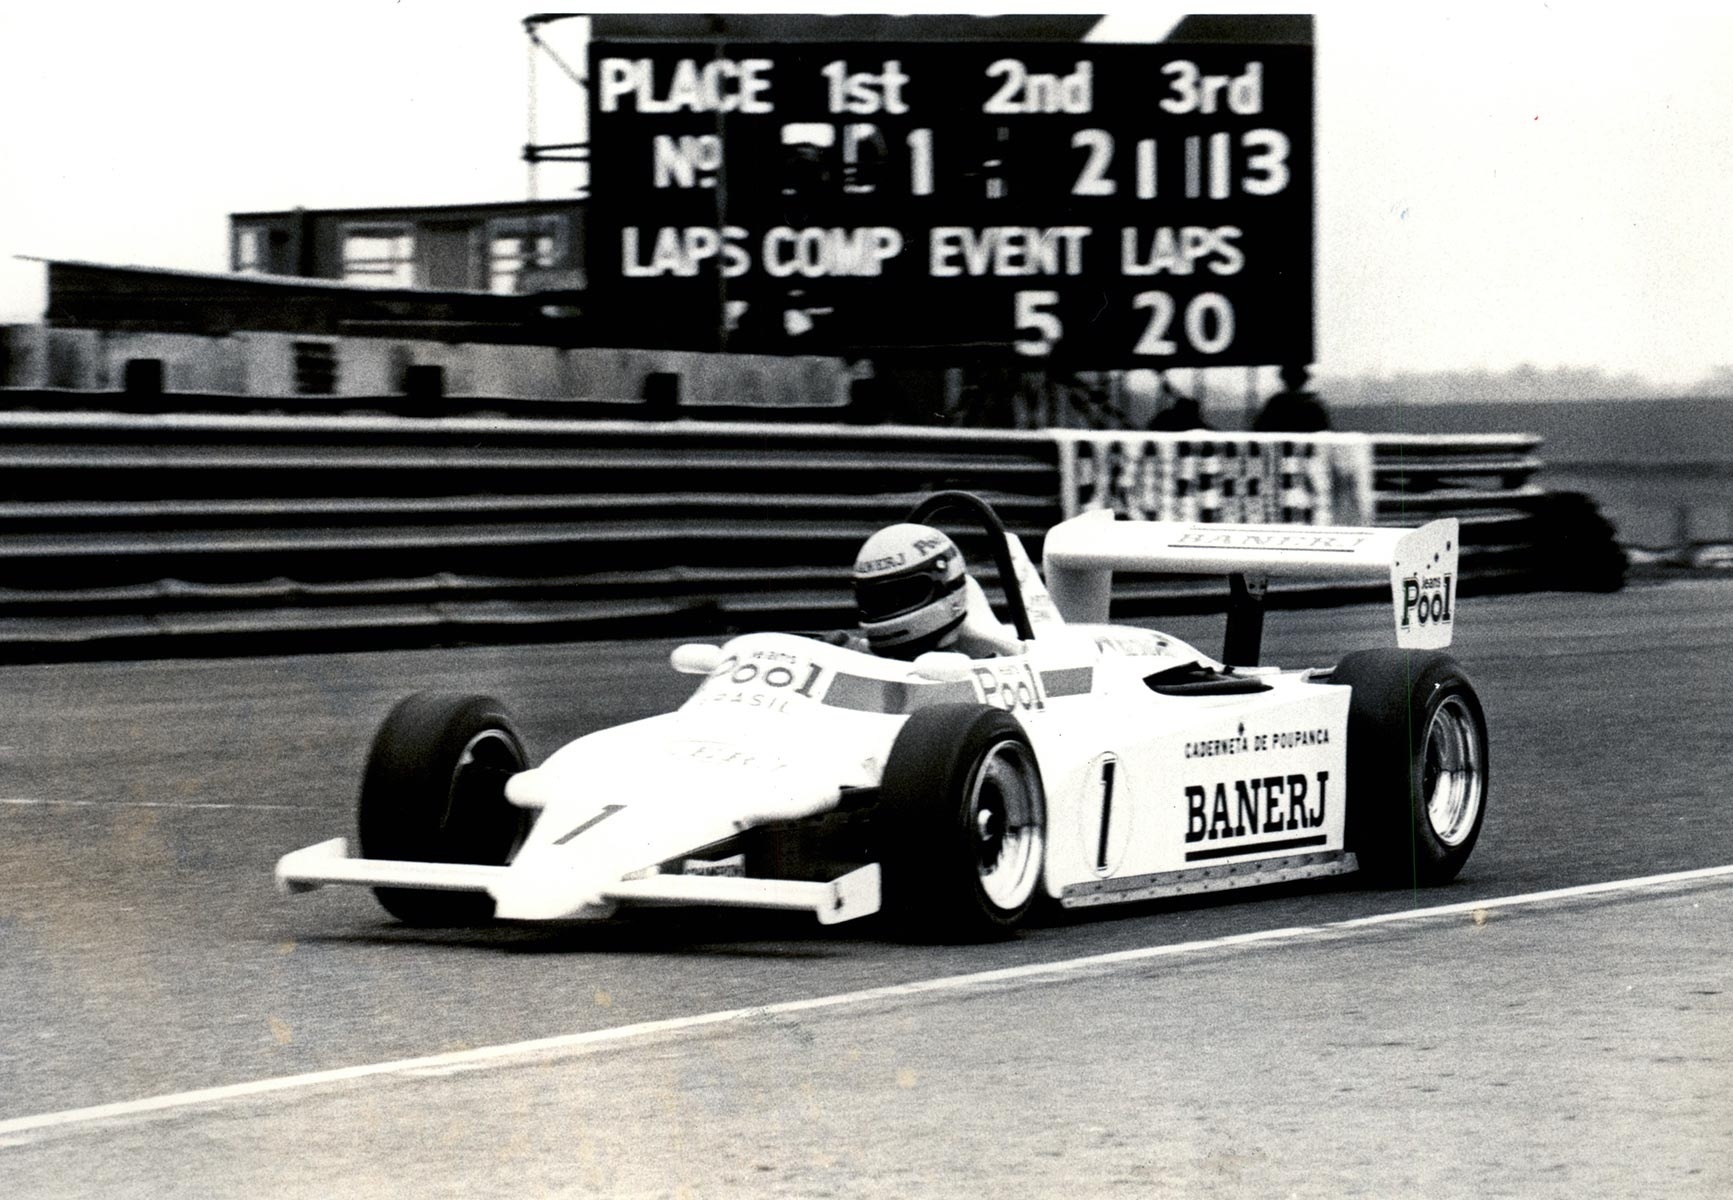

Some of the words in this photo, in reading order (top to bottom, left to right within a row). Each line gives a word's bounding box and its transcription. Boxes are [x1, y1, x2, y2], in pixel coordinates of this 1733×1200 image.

[600, 58, 775, 115] PLACE
[823, 60, 910, 116] 1st
[983, 59, 1093, 115] 2nd
[1161, 60, 1263, 115] 3rd
[907, 128, 934, 197] 1
[1071, 128, 1118, 197] 2
[623, 226, 751, 279] LAPS
[763, 226, 904, 279] COMP
[930, 226, 1093, 279] EVENT
[1121, 226, 1245, 278] LAPS
[1014, 291, 1063, 357] 5
[1134, 292, 1236, 356] 20
[1400, 572, 1453, 630] Pool
[970, 661, 1046, 714] Pool
[1184, 736, 1248, 759] CADERNETA
[1253, 733, 1269, 752] DE
[551, 803, 628, 846] 1
[1096, 757, 1117, 872] 1
[1184, 770, 1330, 844] BANERJ
